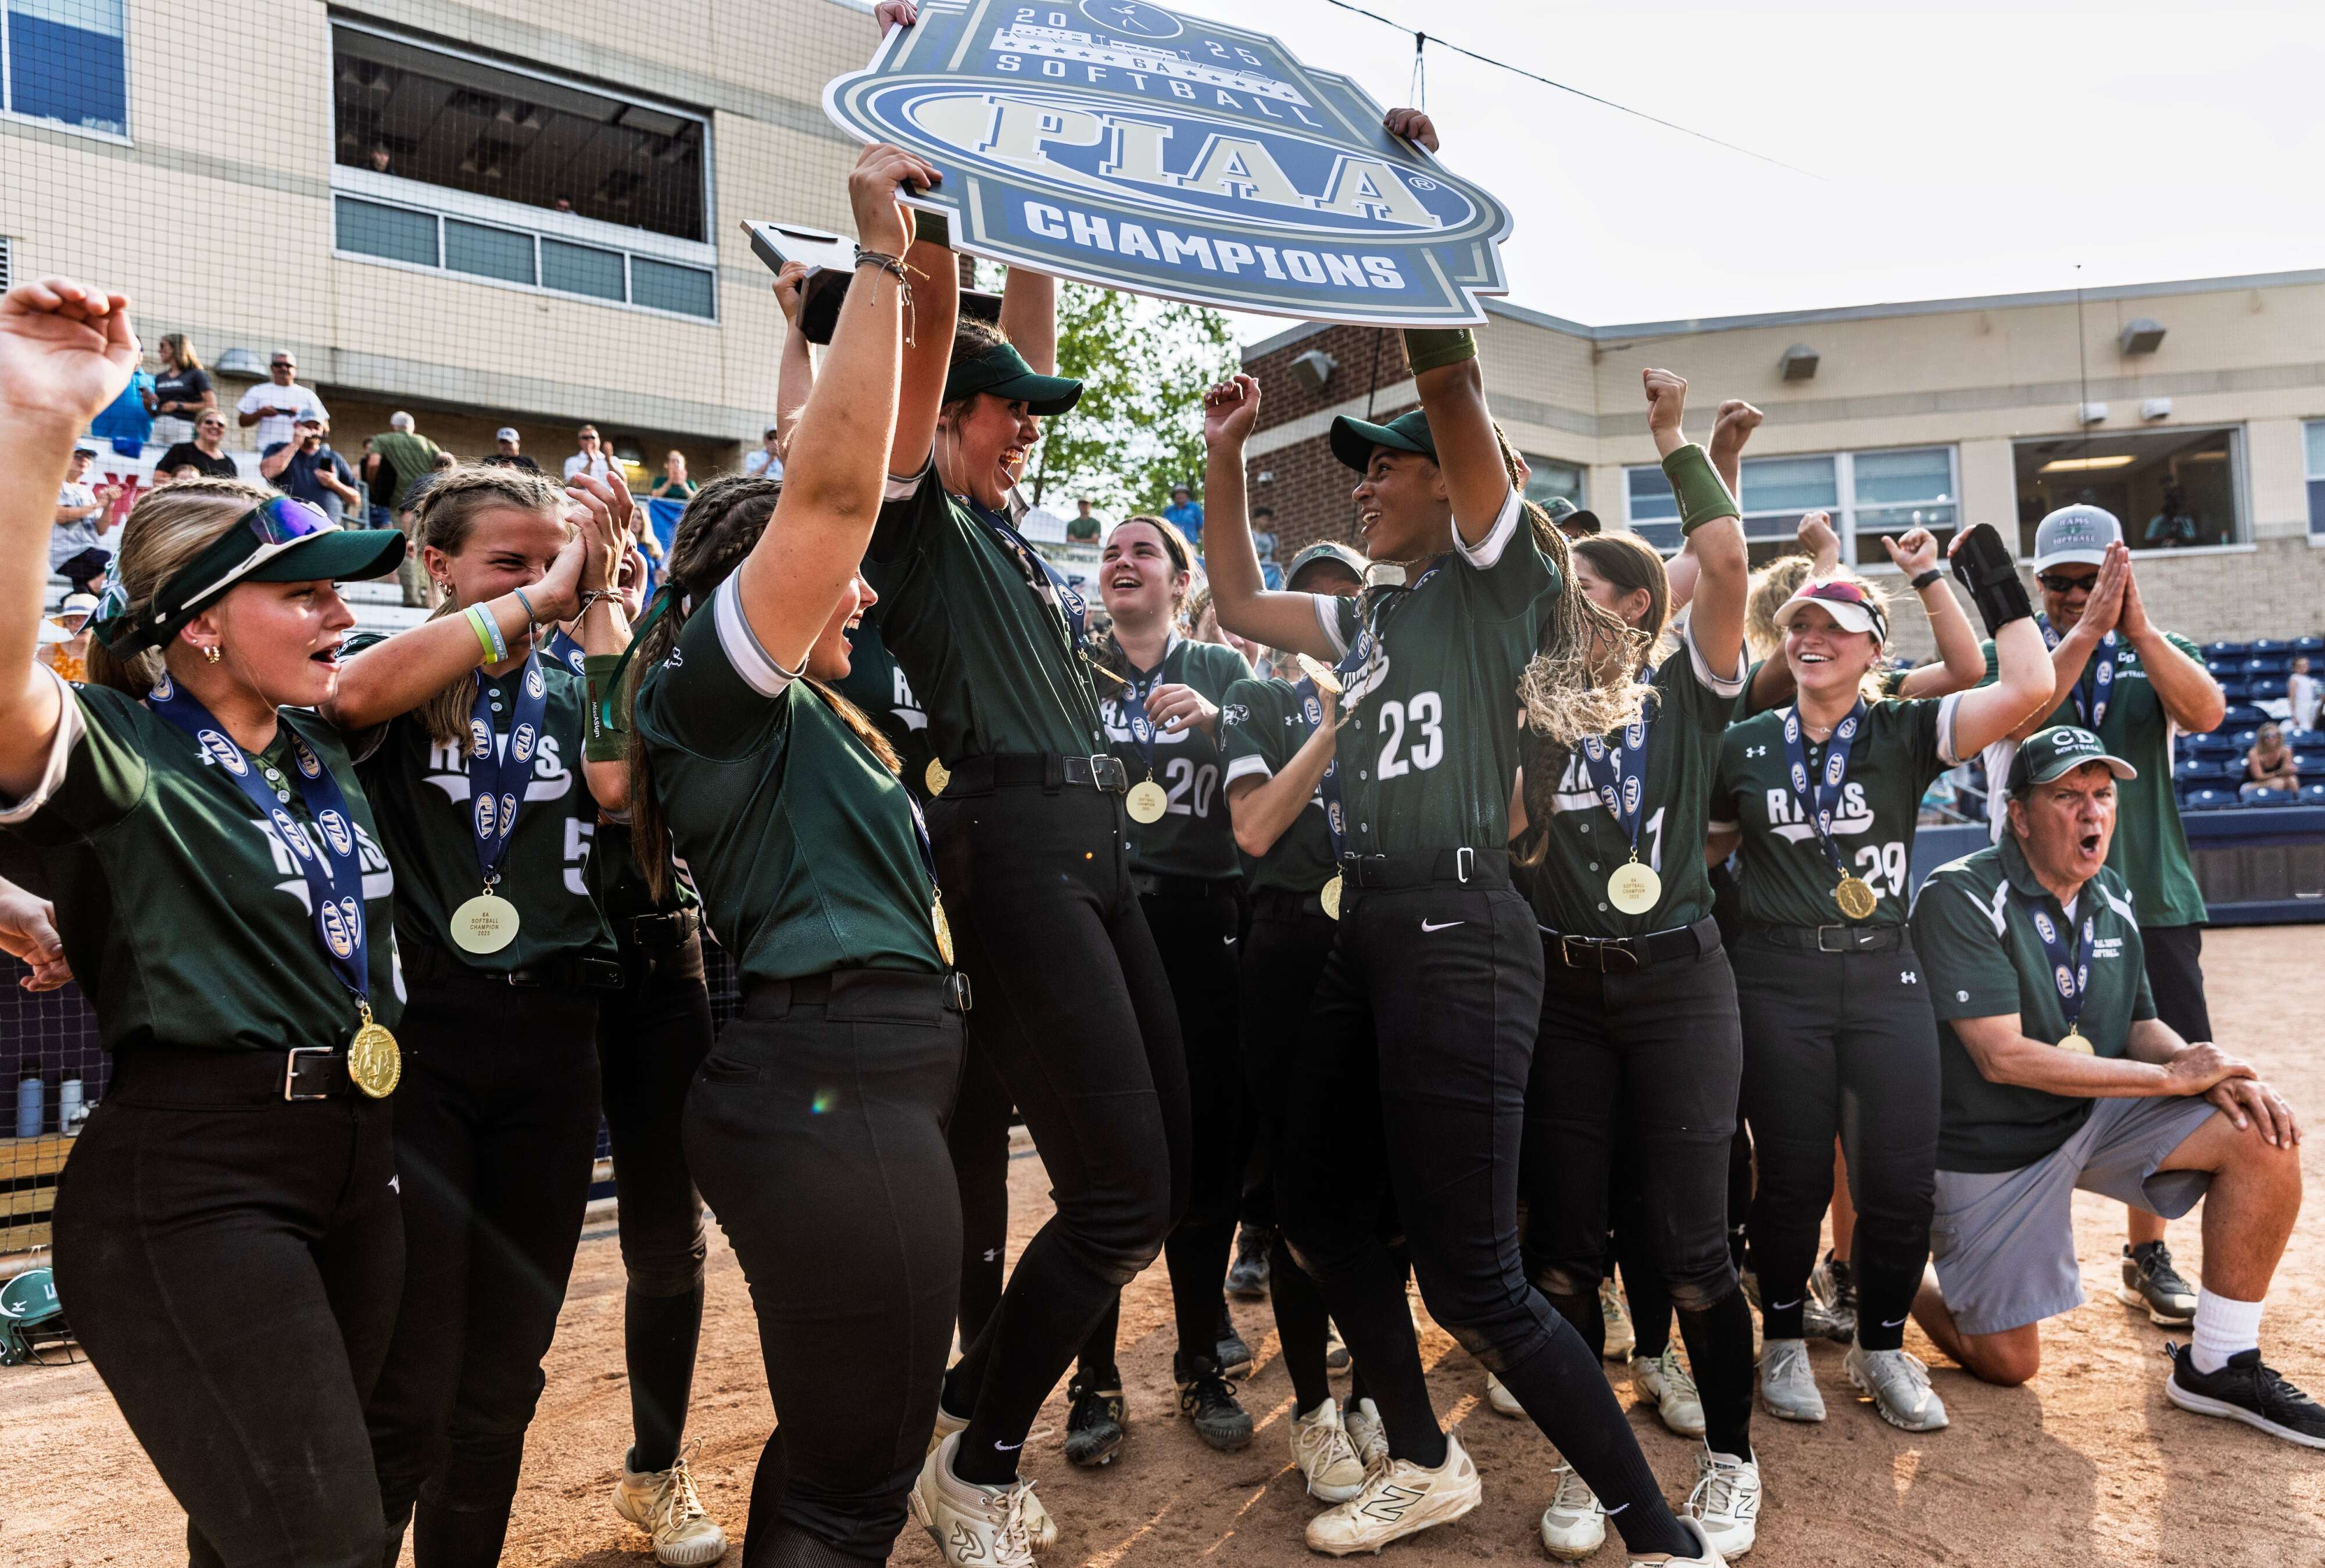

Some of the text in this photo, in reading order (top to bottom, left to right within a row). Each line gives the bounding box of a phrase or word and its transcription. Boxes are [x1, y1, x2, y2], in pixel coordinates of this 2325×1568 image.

[1016, 8, 1262, 67] 20 25
[1133, 58, 1172, 74] 6A
[996, 54, 1324, 128] SOFTBALL
[972, 92, 1443, 230] PIAA
[1024, 200, 1406, 290] CHAMPIONS
[2059, 516, 2089, 526] RAMS
[201, 732, 247, 774] PIAA
[430, 734, 562, 778] RS
[515, 725, 534, 759] PIAA
[1378, 690, 1444, 782] 23
[1628, 722, 1641, 748] PIA
[2052, 729, 2095, 746] CD
[1165, 757, 1218, 818] 20
[1829, 755, 1843, 786] PIAA
[477, 796, 495, 837] PIAA
[1626, 778, 1637, 812] PIAA
[1766, 782, 1866, 824] RS
[250, 819, 388, 876] RS
[274, 813, 310, 857] PIAA
[321, 812, 350, 852] PIAA
[563, 817, 595, 896] 5
[1855, 842, 1907, 899] 29
[324, 904, 349, 951] PIAA
